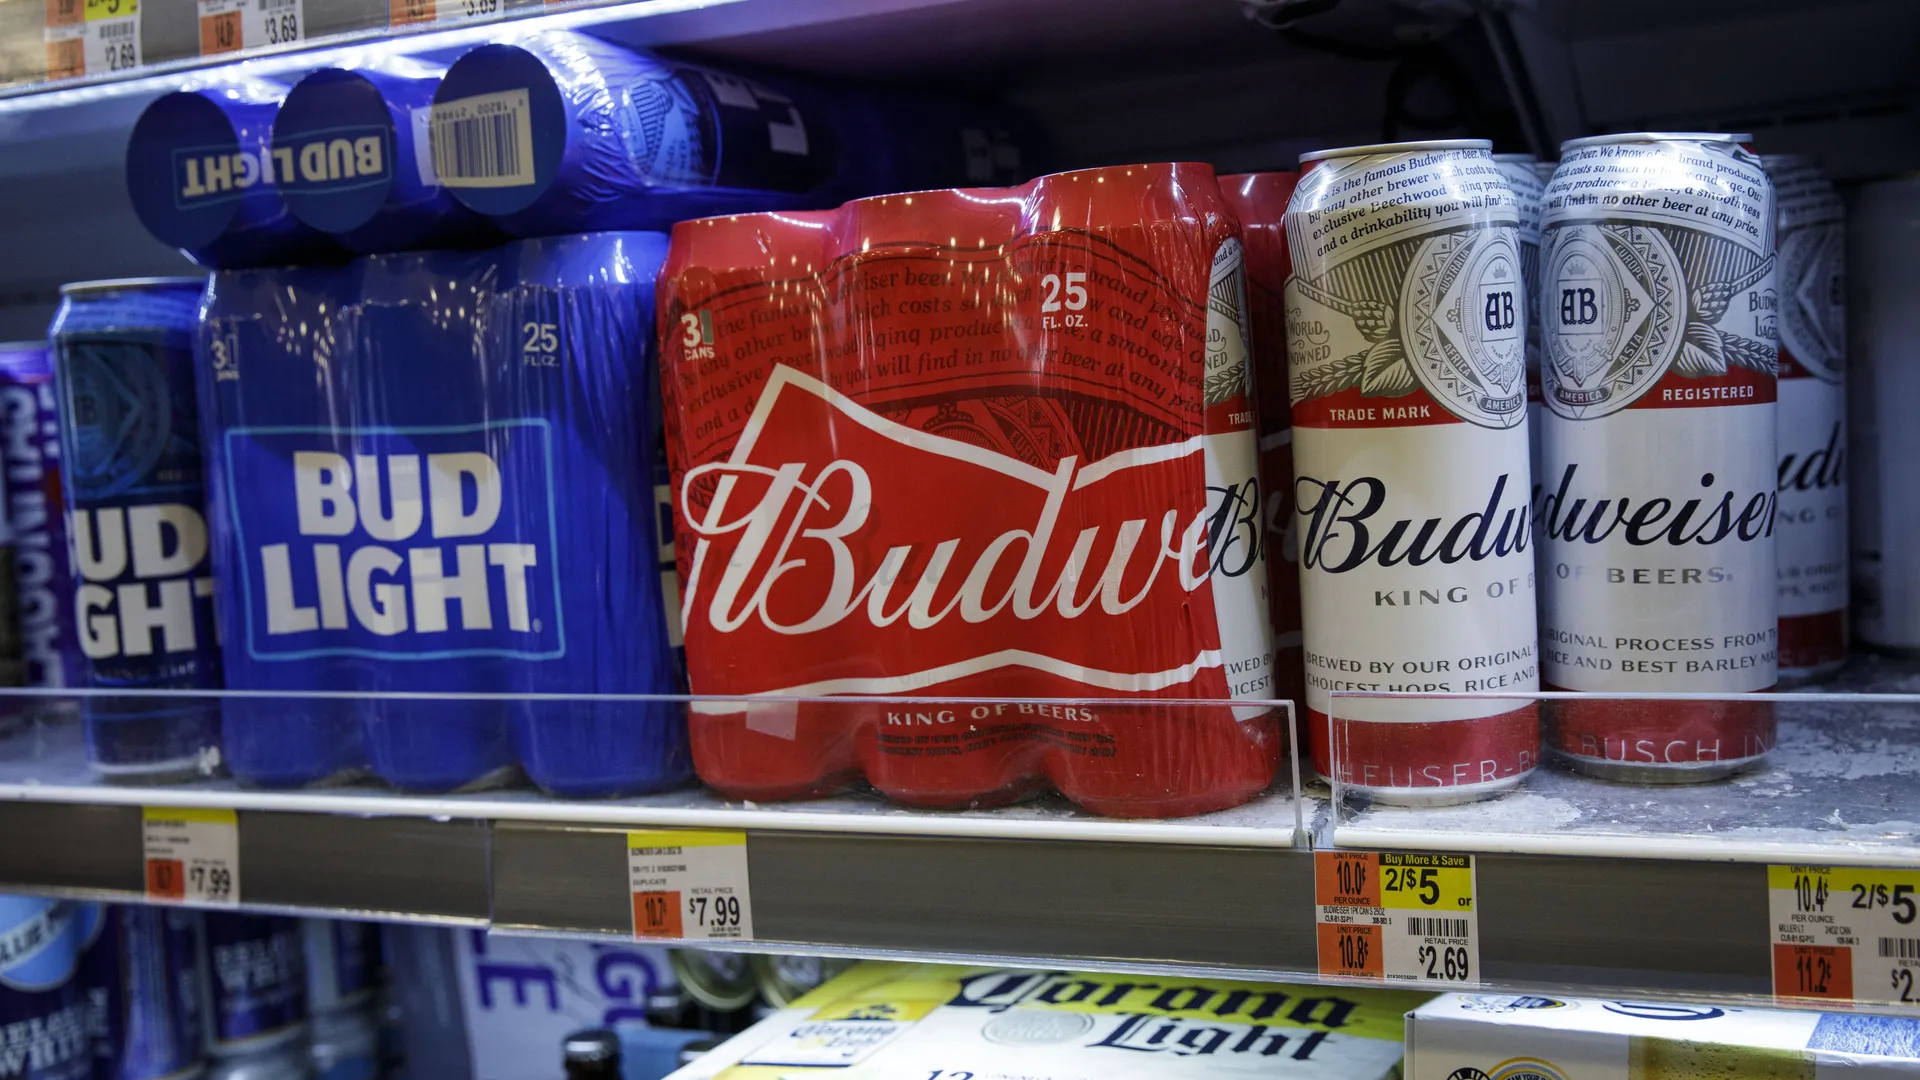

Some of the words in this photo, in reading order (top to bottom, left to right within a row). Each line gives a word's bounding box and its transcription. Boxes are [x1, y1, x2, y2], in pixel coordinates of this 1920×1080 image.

[182, 147, 297, 198] LIGHT
[300, 136, 383, 182] BUD
[1331, 186, 1341, 197] is
[1343, 178, 1362, 192] the
[1363, 163, 1406, 186] famous
[1408, 149, 1461, 170] Budweiser
[1461, 149, 1480, 160] beer.
[1579, 148, 1598, 160] beer.
[1600, 146, 1614, 157] We
[1615, 146, 1645, 158] know
[1679, 153, 1713, 169] brand
[1716, 163, 1762, 188] produced
[1308, 210, 1321, 225] by
[1324, 199, 1346, 216] any
[1349, 185, 1384, 204] other
[1387, 173, 1430, 192] brewer
[1465, 164, 1487, 176] costs
[1569, 164, 1591, 176] costs
[1593, 165, 1606, 173] so
[1695, 173, 1719, 186] and
[1747, 187, 1764, 203] Our
[1572, 177, 1628, 191] produces
[1684, 186, 1693, 195] a
[1697, 188, 1761, 219] smoothness
[1312, 207, 1366, 240] exclusive
[1369, 183, 1448, 214] Beechwood
[1317, 237, 1338, 257] and
[1339, 235, 1349, 245] a
[1350, 207, 1431, 240] drinkability
[1435, 201, 1460, 217] you
[1462, 196, 1483, 209] will
[1485, 194, 1502, 209] find
[1563, 193, 1586, 209] find
[1587, 193, 1599, 205] in
[1602, 195, 1619, 205] no
[1622, 194, 1660, 208] other
[1662, 196, 1693, 213] beer
[1694, 205, 1709, 217] at
[1711, 210, 1734, 226] any
[1733, 218, 1760, 238] price.
[1439, 248, 1471, 295] AUSTRALIA
[1615, 244, 1646, 281] EUROPE
[1040, 271, 1089, 313] 25
[1090, 268, 1149, 304] brand
[1042, 316, 1062, 330] FL.
[1065, 314, 1089, 328] OZ.
[1484, 291, 1516, 331] AB
[1560, 287, 1599, 325] AB
[523, 321, 559, 353] 25
[681, 312, 701, 348] 3
[734, 332, 786, 362] other
[898, 295, 952, 316] costs
[1108, 304, 1149, 331] and
[683, 346, 716, 362] CANS
[1443, 343, 1472, 378] AFRICA
[1619, 334, 1645, 365] ASIA
[689, 366, 764, 414] exclusive
[876, 354, 911, 377] will
[918, 349, 959, 376] find
[965, 348, 984, 366] in
[990, 347, 1012, 363] no
[1062, 345, 1101, 372] beer
[1105, 362, 1125, 378] at
[1130, 371, 1168, 400] any
[1485, 394, 1521, 411] AMERICA
[1559, 390, 1603, 403] AMERICA
[1663, 385, 1754, 401] REGISTERED
[696, 410, 723, 438] and
[1328, 407, 1377, 422] TRADE
[1382, 404, 1431, 420] MARK
[293, 450, 503, 541] BUD
[260, 542, 538, 636] LIGHT
[1374, 586, 1468, 607] KING
[1486, 577, 1520, 599] OF
[1615, 637, 1715, 651] PROCESS
[1723, 631, 1766, 649] FROM
[1306, 652, 1362, 673] BREWED
[1369, 661, 1395, 675] BY
[1402, 660, 1451, 674] OUR
[1458, 645, 1533, 672] ORIGINAL
[1574, 655, 1613, 671] AND
[1621, 660, 1678, 673] BEST
[1686, 655, 1758, 673] BARLEY
[1307, 672, 1380, 692] CHOICEST
[1464, 674, 1508, 693] RICE
[1512, 666, 1535, 684] AND
[888, 710, 956, 727] KING
[970, 703, 1009, 720] OF
[1334, 852, 1349, 860] UNIT
[1385, 853, 1403, 866] Buy
[1405, 854, 1429, 866] More
[1432, 855, 1440, 866] &
[1441, 855, 1465, 866] Save
[1790, 866, 1808, 874] UNIT
[1808, 867, 1832, 875] PRICE
[689, 896, 740, 926] $7.99
[1323, 906, 1350, 915] BUDWEISER
[1349, 897, 1371, 905] OUNCE
[1457, 897, 1473, 907] or
[1791, 914, 1807, 922] PER
[1808, 915, 1835, 923] OUNCE
[1337, 926, 1352, 934] UNIT
[1353, 927, 1373, 935] PRICE
[1424, 937, 1448, 945] RETAIL
[1449, 938, 1469, 946] PRICE
[1418, 945, 1469, 981] $2.69
[943, 972, 1360, 1030] Corona
[1084, 1011, 1338, 1061] Light
